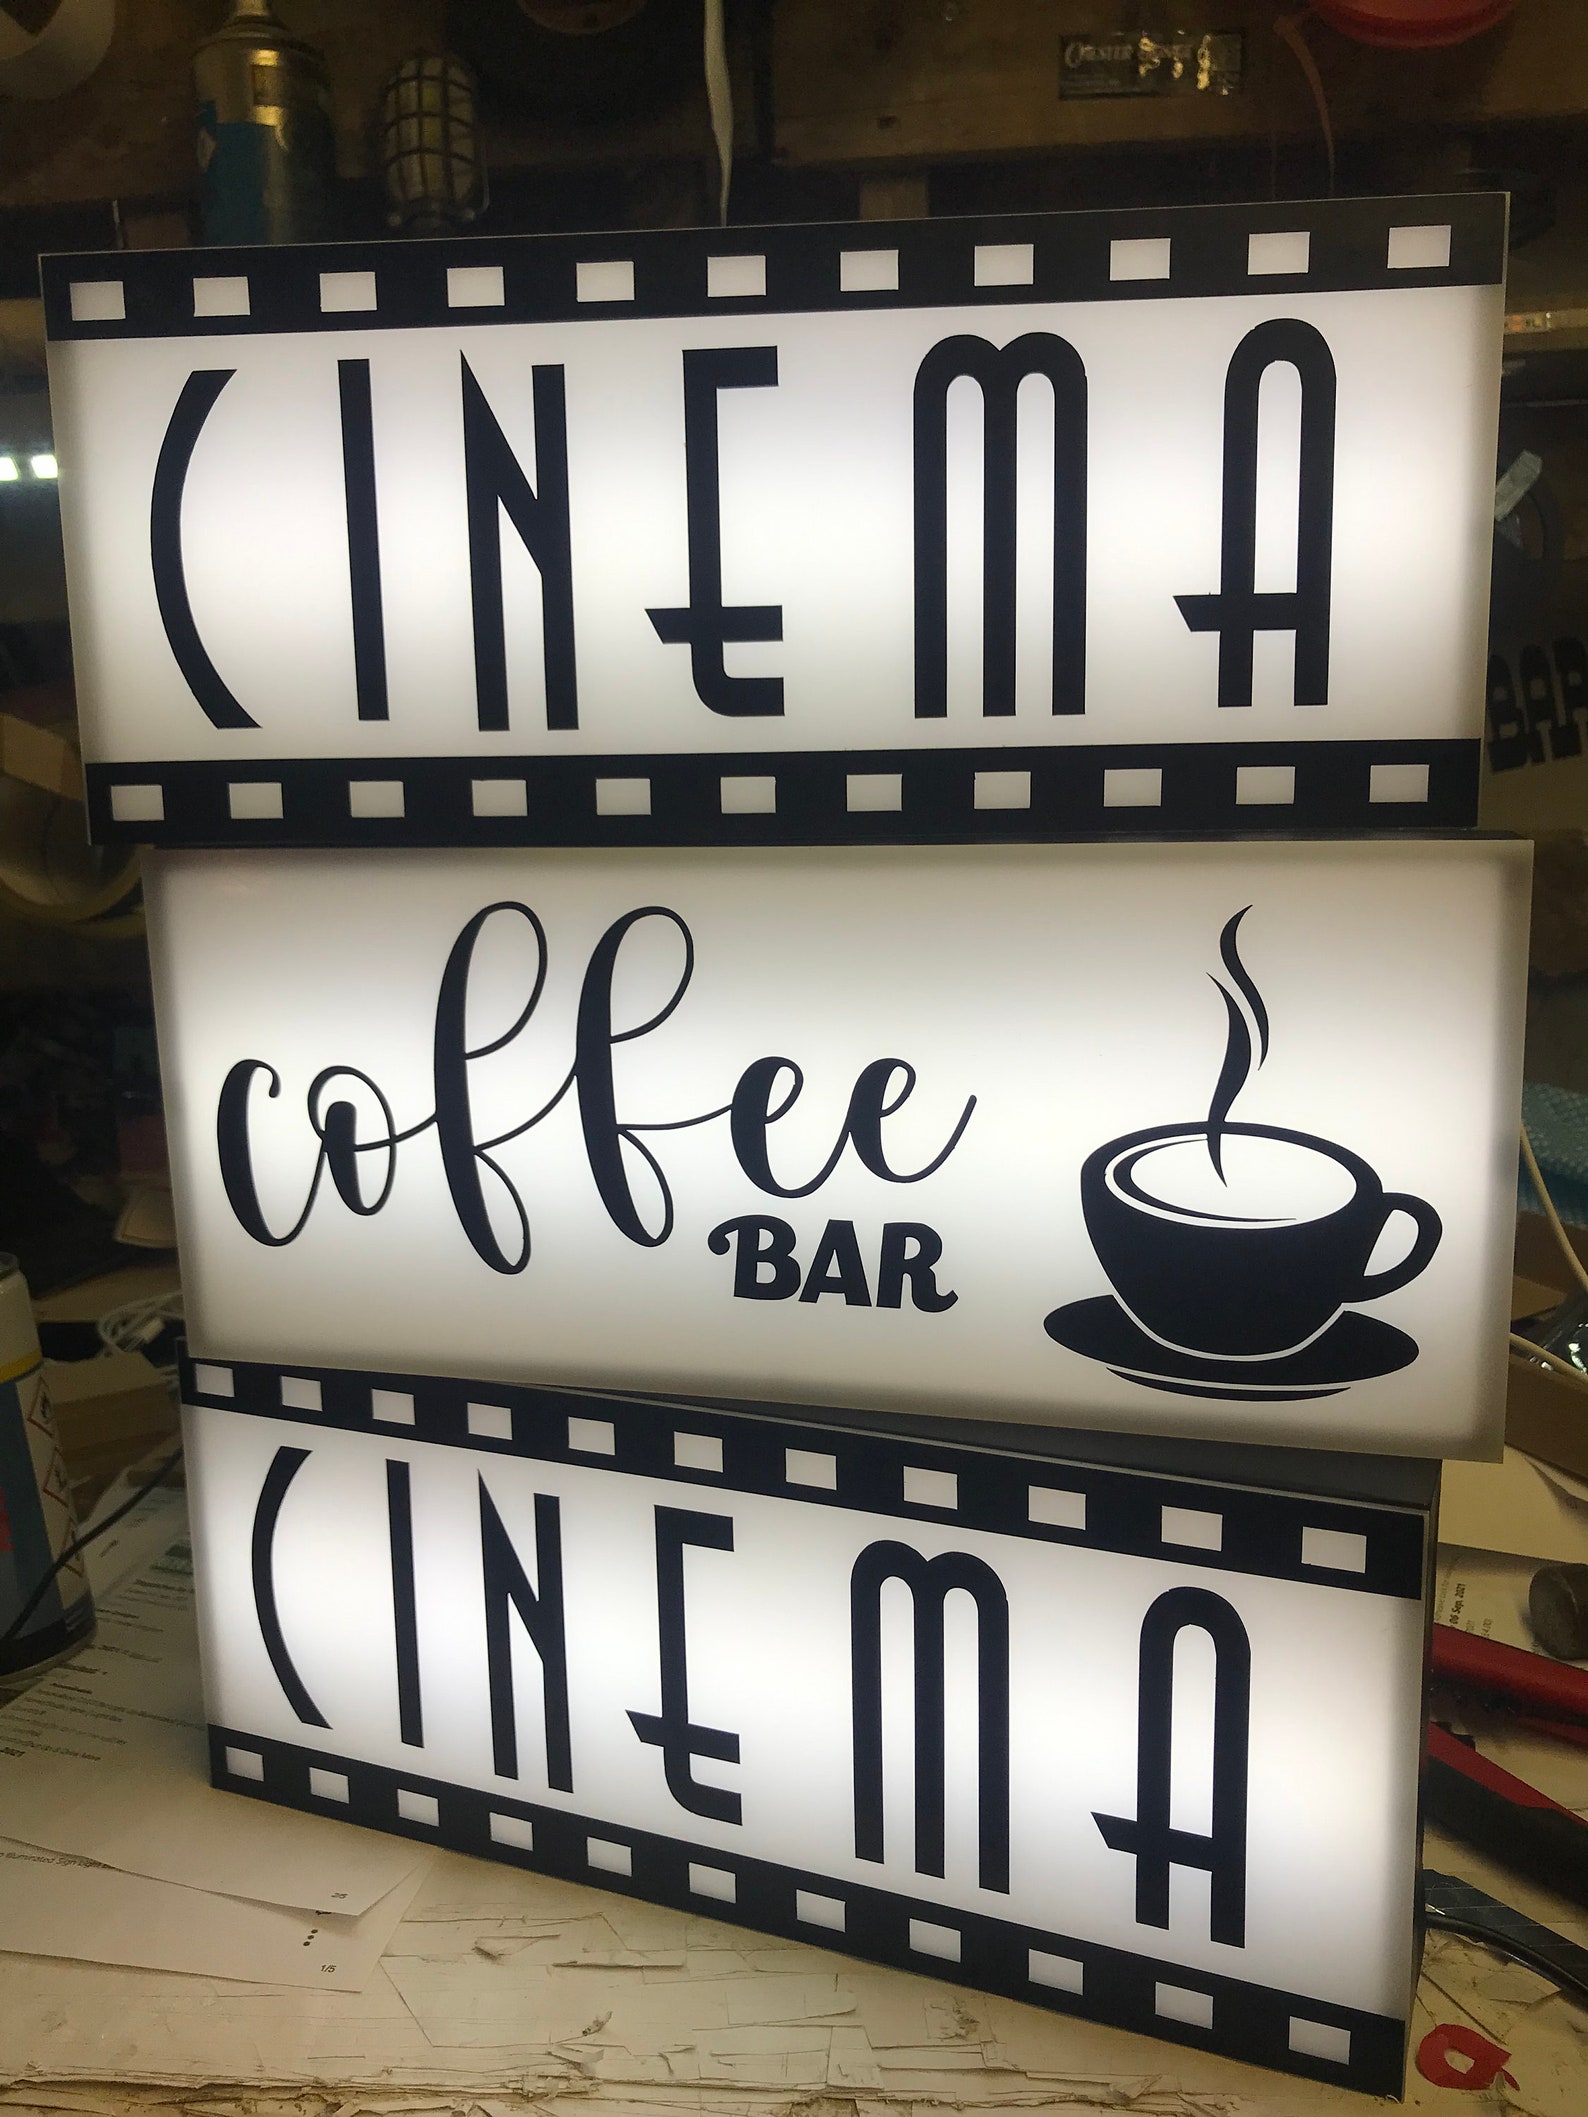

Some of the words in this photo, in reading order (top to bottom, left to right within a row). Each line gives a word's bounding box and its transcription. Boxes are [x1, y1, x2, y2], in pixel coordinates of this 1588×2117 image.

[151, 318, 1336, 731] CINEMA
[217, 901, 976, 1274] coffee
[708, 1215, 958, 1312] BAR
[252, 1446, 1251, 1948] CINEMA
[321, 1964, 337, 1973] 1/5
